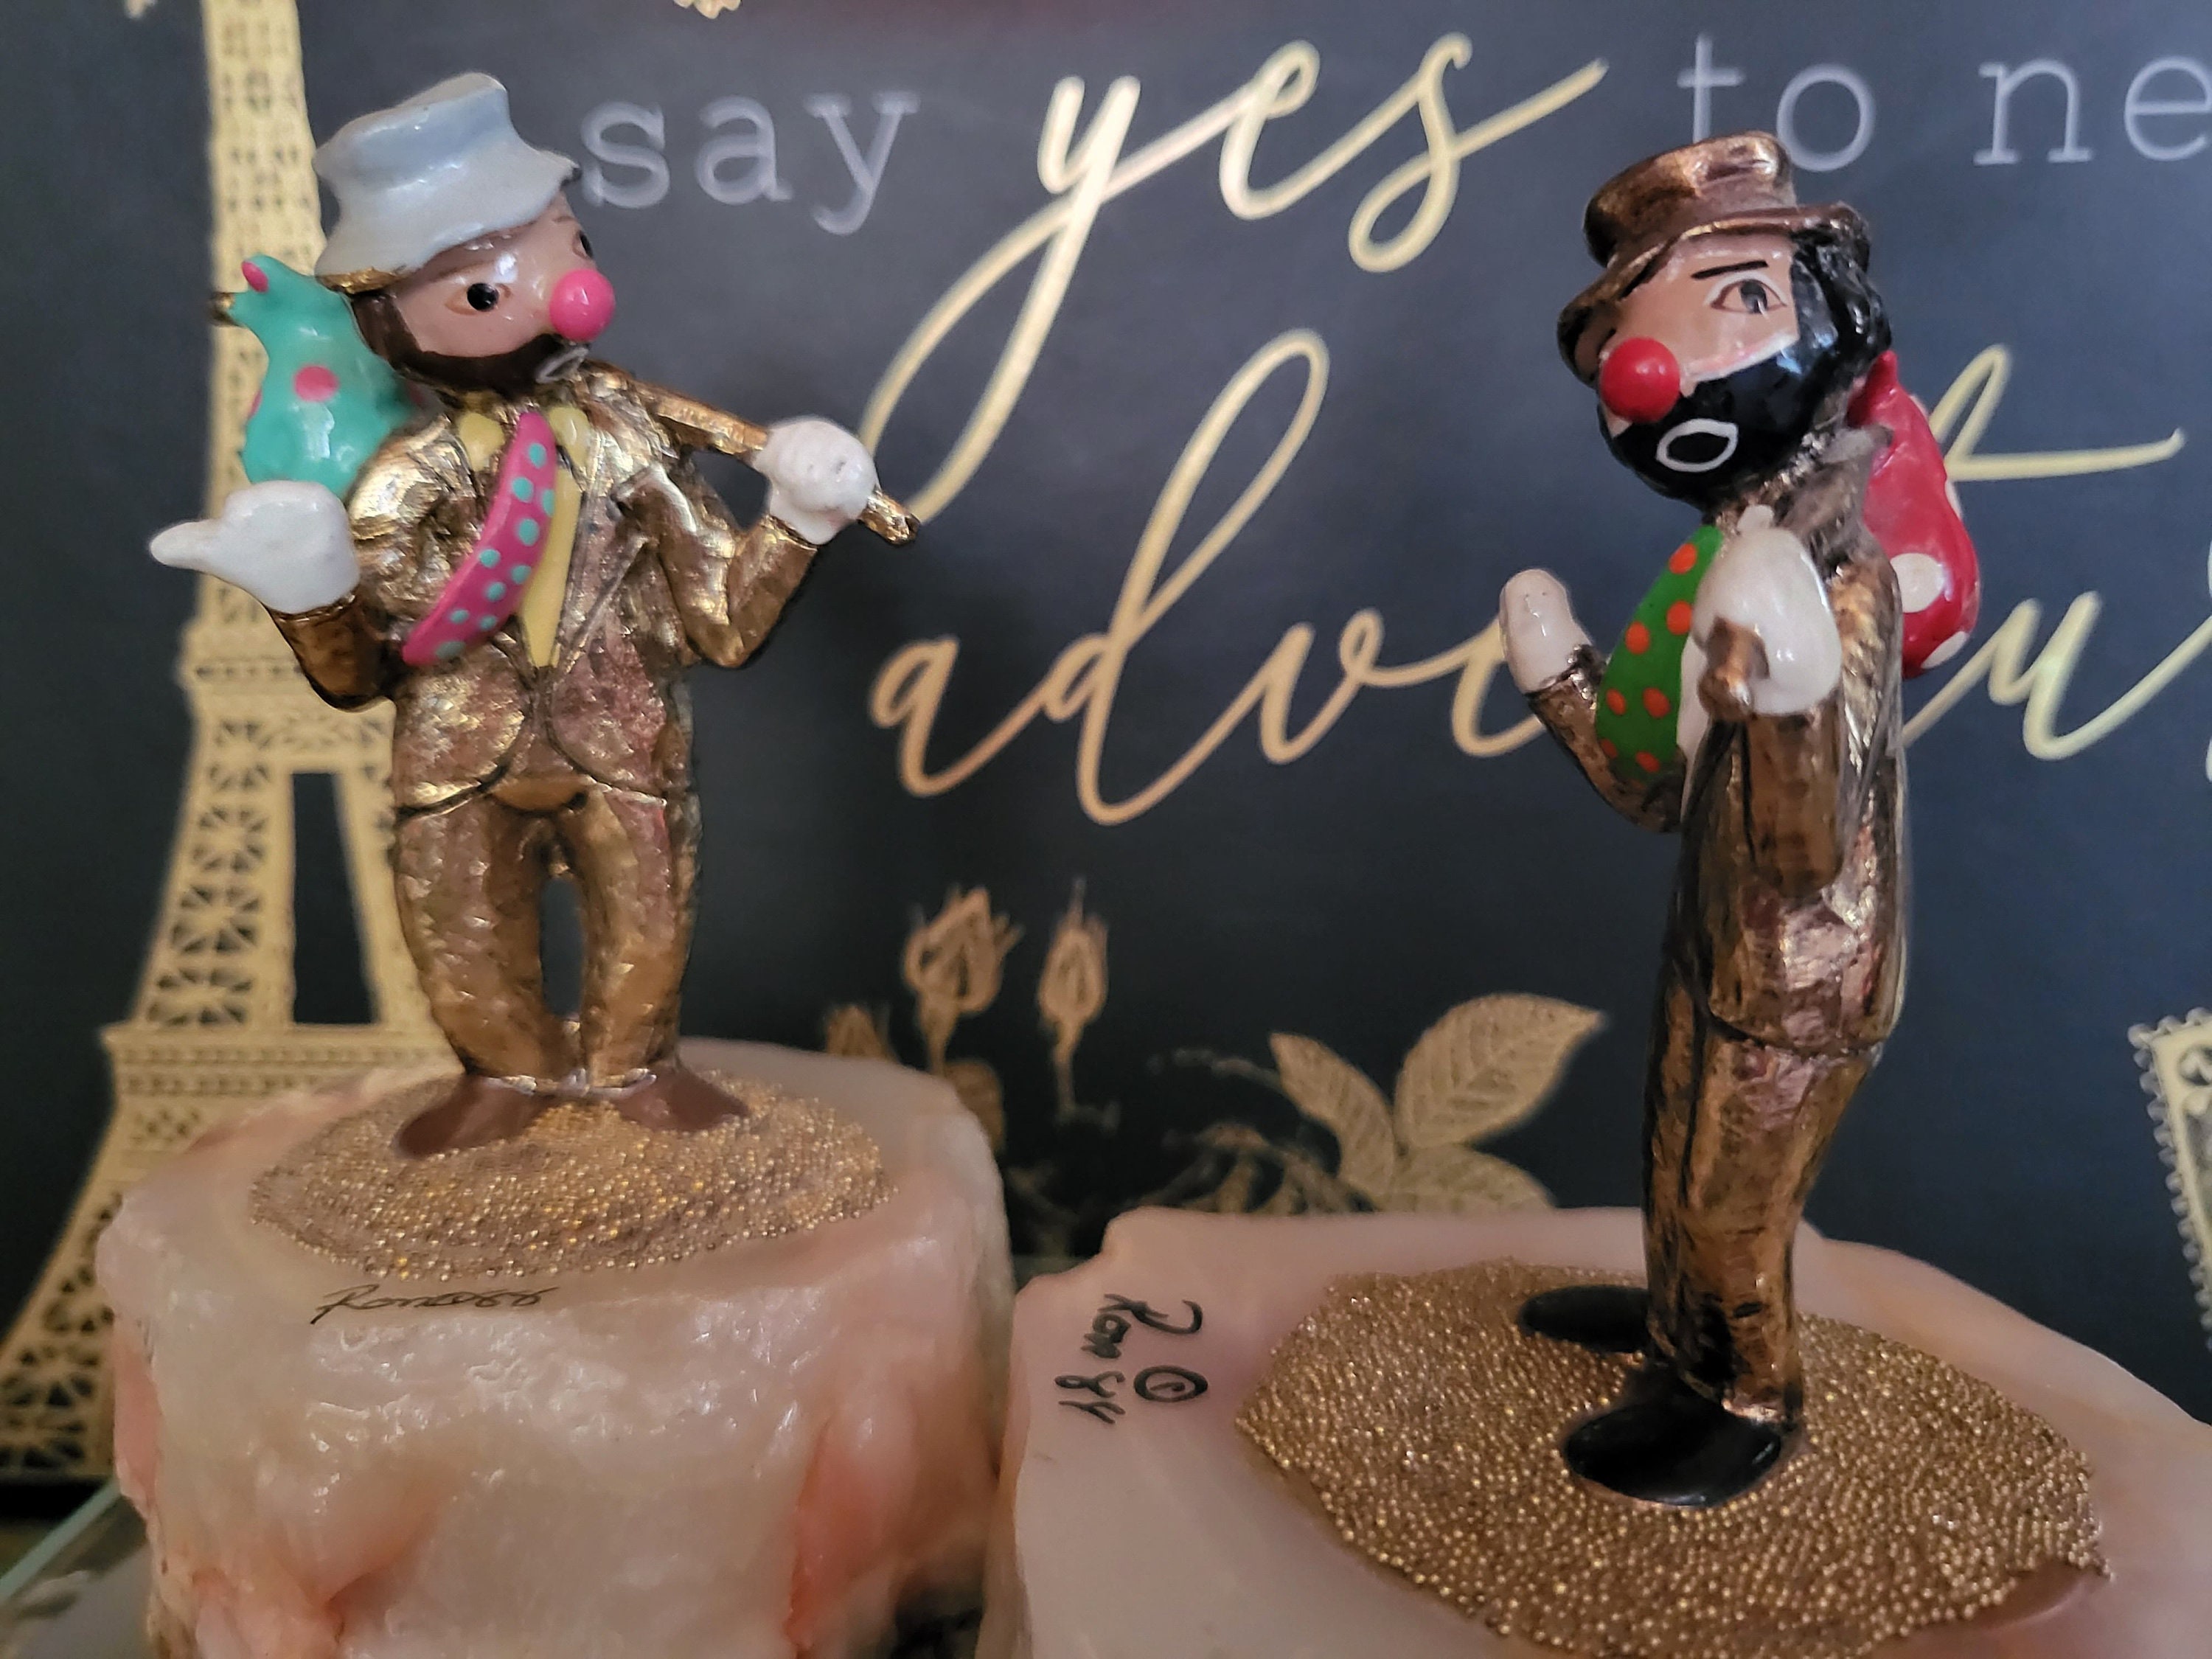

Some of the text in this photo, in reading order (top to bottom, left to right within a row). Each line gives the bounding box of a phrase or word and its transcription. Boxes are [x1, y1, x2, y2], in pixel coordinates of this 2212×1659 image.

[580, 91, 922, 236] say
[857, 31, 1612, 521] yes
[1677, 33, 1877, 172] to
